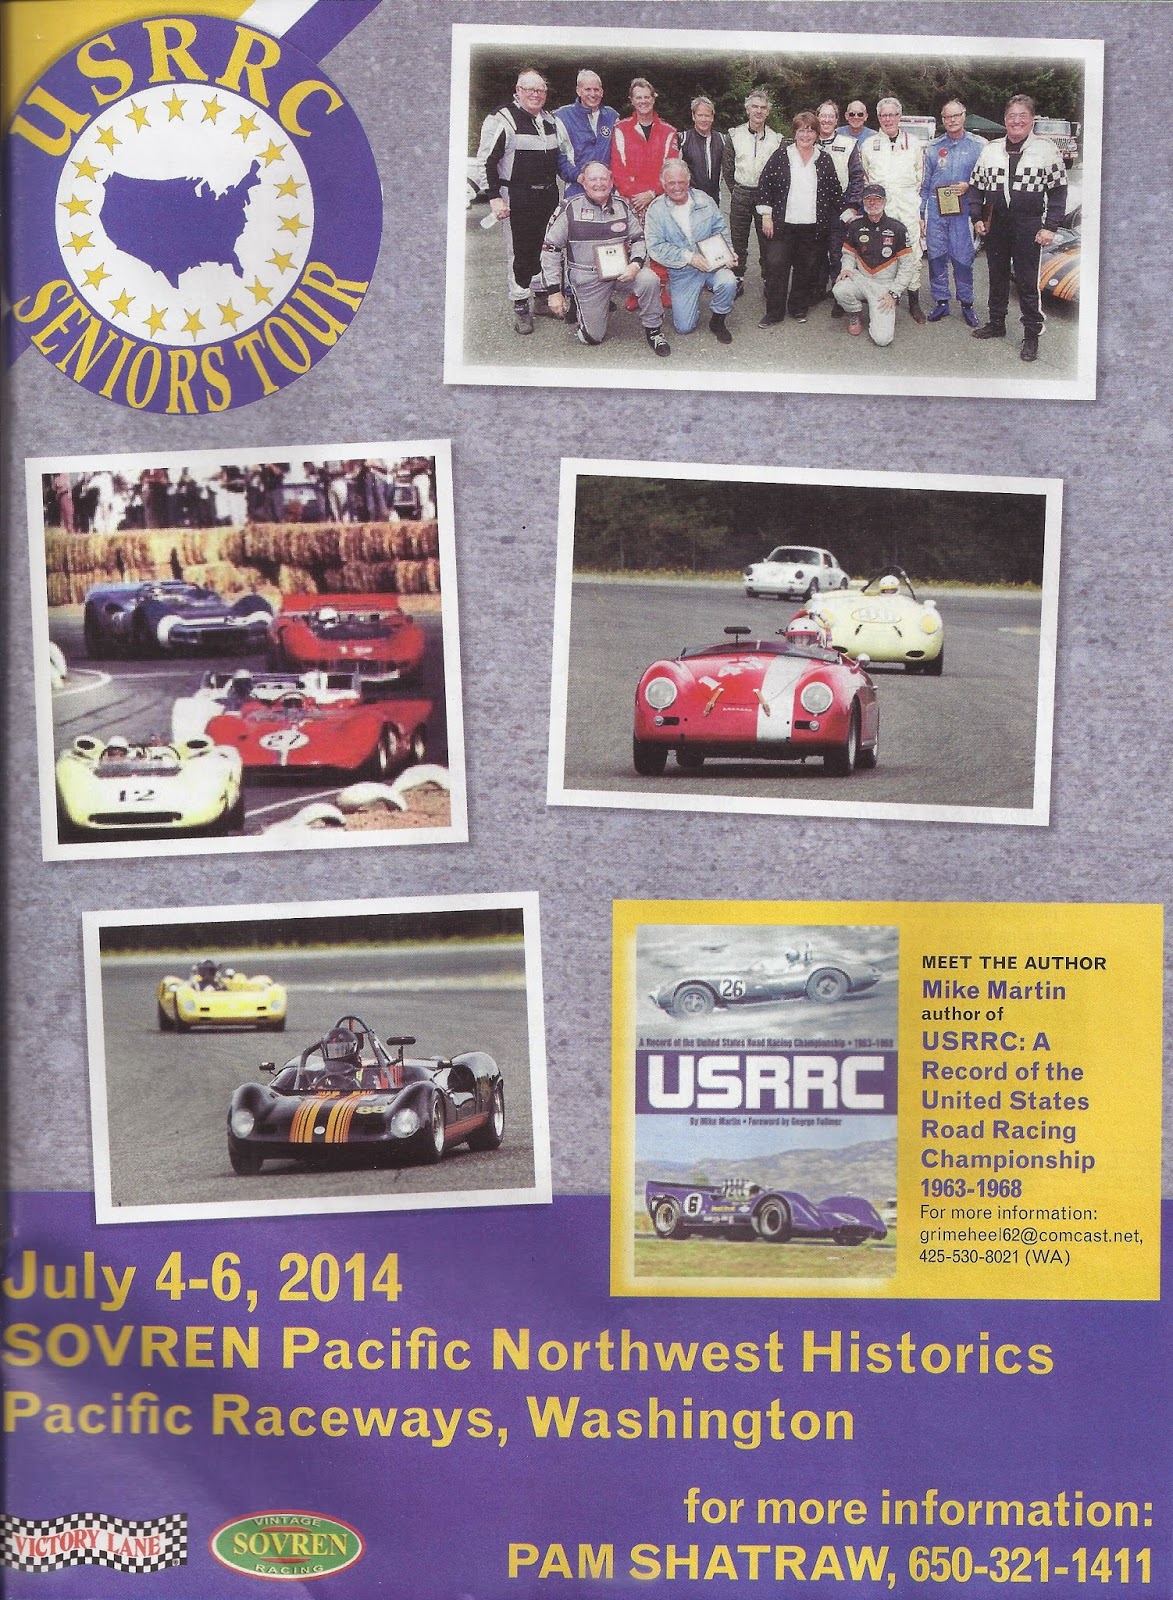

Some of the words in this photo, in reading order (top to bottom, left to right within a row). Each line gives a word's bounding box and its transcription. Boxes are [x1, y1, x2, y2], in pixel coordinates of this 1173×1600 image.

[10, 18, 343, 157] USRRC
[14, 279, 233, 413] SENIORS
[235, 261, 370, 396] TOUR
[922, 955, 972, 970] MEET
[979, 955, 1018, 970] THE
[1024, 955, 1107, 971] AUTHOR
[723, 980, 742, 997] 26
[922, 980, 980, 1000] Mike
[987, 980, 1066, 1000] Martin
[921, 1007, 981, 1022] author
[985, 1007, 1004, 1022] of
[922, 1031, 1026, 1052] USRRC:
[1032, 1032, 1051, 1052] A
[922, 1061, 1008, 1081] Record
[1015, 1061, 1040, 1081] of
[1046, 1061, 1084, 1081] the
[647, 1055, 884, 1109] USRRC
[922, 1090, 1001, 1110] United
[1009, 1090, 1090, 1111] States
[922, 1120, 985, 1139] Road
[992, 1120, 1077, 1144] Racing
[921, 1149, 1096, 1173] Championship
[921, 1178, 1022, 1198] 1963-1968
[920, 1204, 946, 1220] For
[951, 1207, 992, 1220] more
[997, 1204, 1098, 1220] information:
[919, 1227, 1143, 1244] grimeheel62@comcast.net,
[919, 1249, 1019, 1265] 425-530-8021
[1025, 1249, 1071, 1266] (WA)
[3, 1251, 136, 1311] July
[155, 1251, 259, 1312] 4-6,
[279, 1253, 402, 1302] 2014
[3, 1323, 260, 1369] SOVREN
[282, 1327, 471, 1370] Pacific
[492, 1328, 783, 1374] Northwest
[803, 1330, 1055, 1375] Historics
[3, 1391, 193, 1435] Pacific
[212, 1393, 508, 1448] Raceways,
[527, 1396, 854, 1450] Washington
[684, 1488, 743, 1524] for
[756, 1496, 868, 1525] more
[881, 1489, 1153, 1528] information:
[254, 1517, 321, 1527] VINTAGE
[14, 1529, 100, 1557] VICTORY
[107, 1533, 161, 1557] LANE
[233, 1532, 348, 1556] SOVREN
[256, 1564, 324, 1574] RACING
[508, 1544, 615, 1579] PAM
[629, 1545, 896, 1590] SHATRAW,
[909, 1546, 1153, 1583] 650-321-1411
